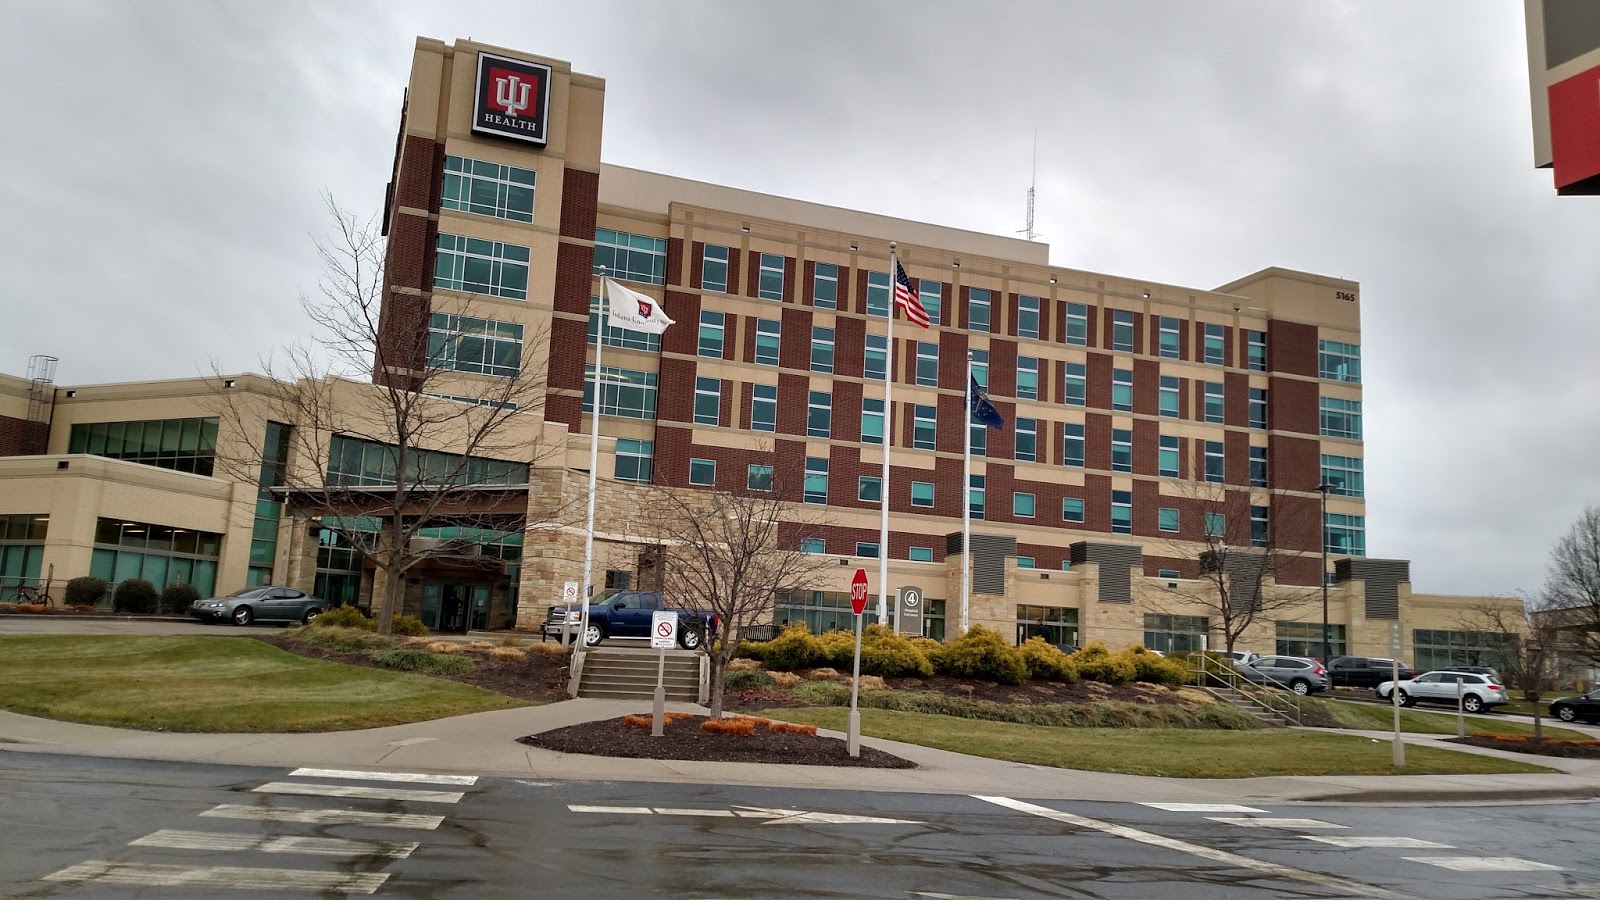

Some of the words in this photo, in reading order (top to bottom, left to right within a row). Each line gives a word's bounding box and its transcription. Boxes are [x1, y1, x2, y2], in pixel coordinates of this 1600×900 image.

[484, 113, 537, 131] HEALTH
[1336, 291, 1355, 301] 5165
[851, 582, 868, 600] STOP
[908, 593, 915, 604] 4
